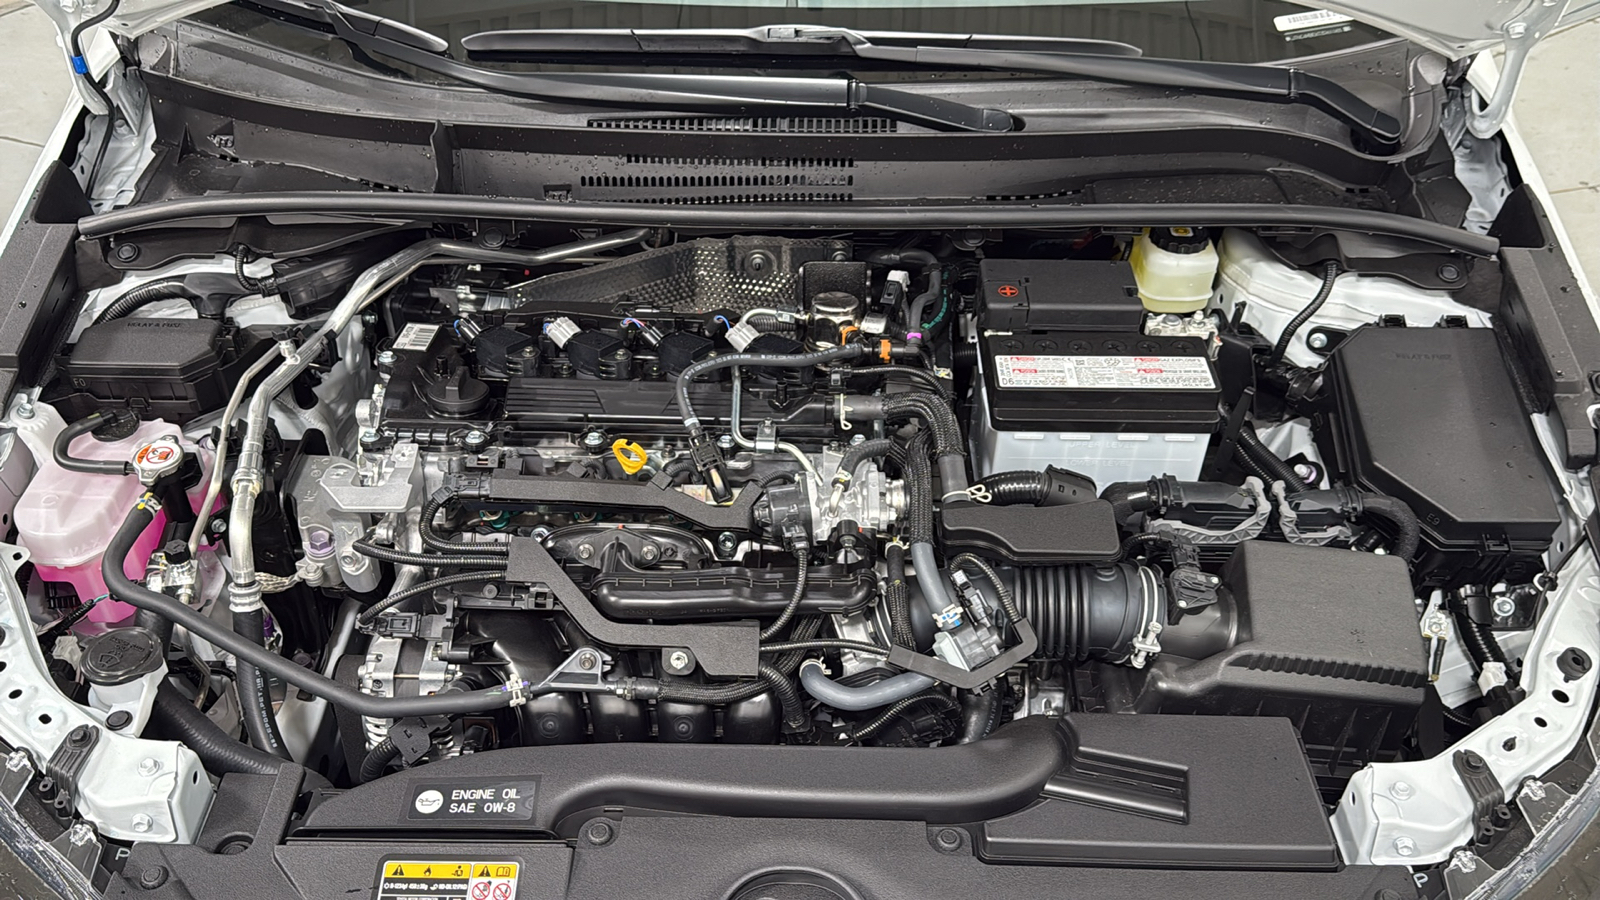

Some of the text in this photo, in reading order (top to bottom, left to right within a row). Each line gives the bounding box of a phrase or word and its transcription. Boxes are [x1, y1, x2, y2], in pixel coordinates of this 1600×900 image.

[1106, 441, 1136, 449] LEVEL
[1065, 459, 1132, 467] LOWER LEVEL
[451, 788, 521, 800] ENGINE OIL
[448, 802, 516, 813] SAE 0W-8
